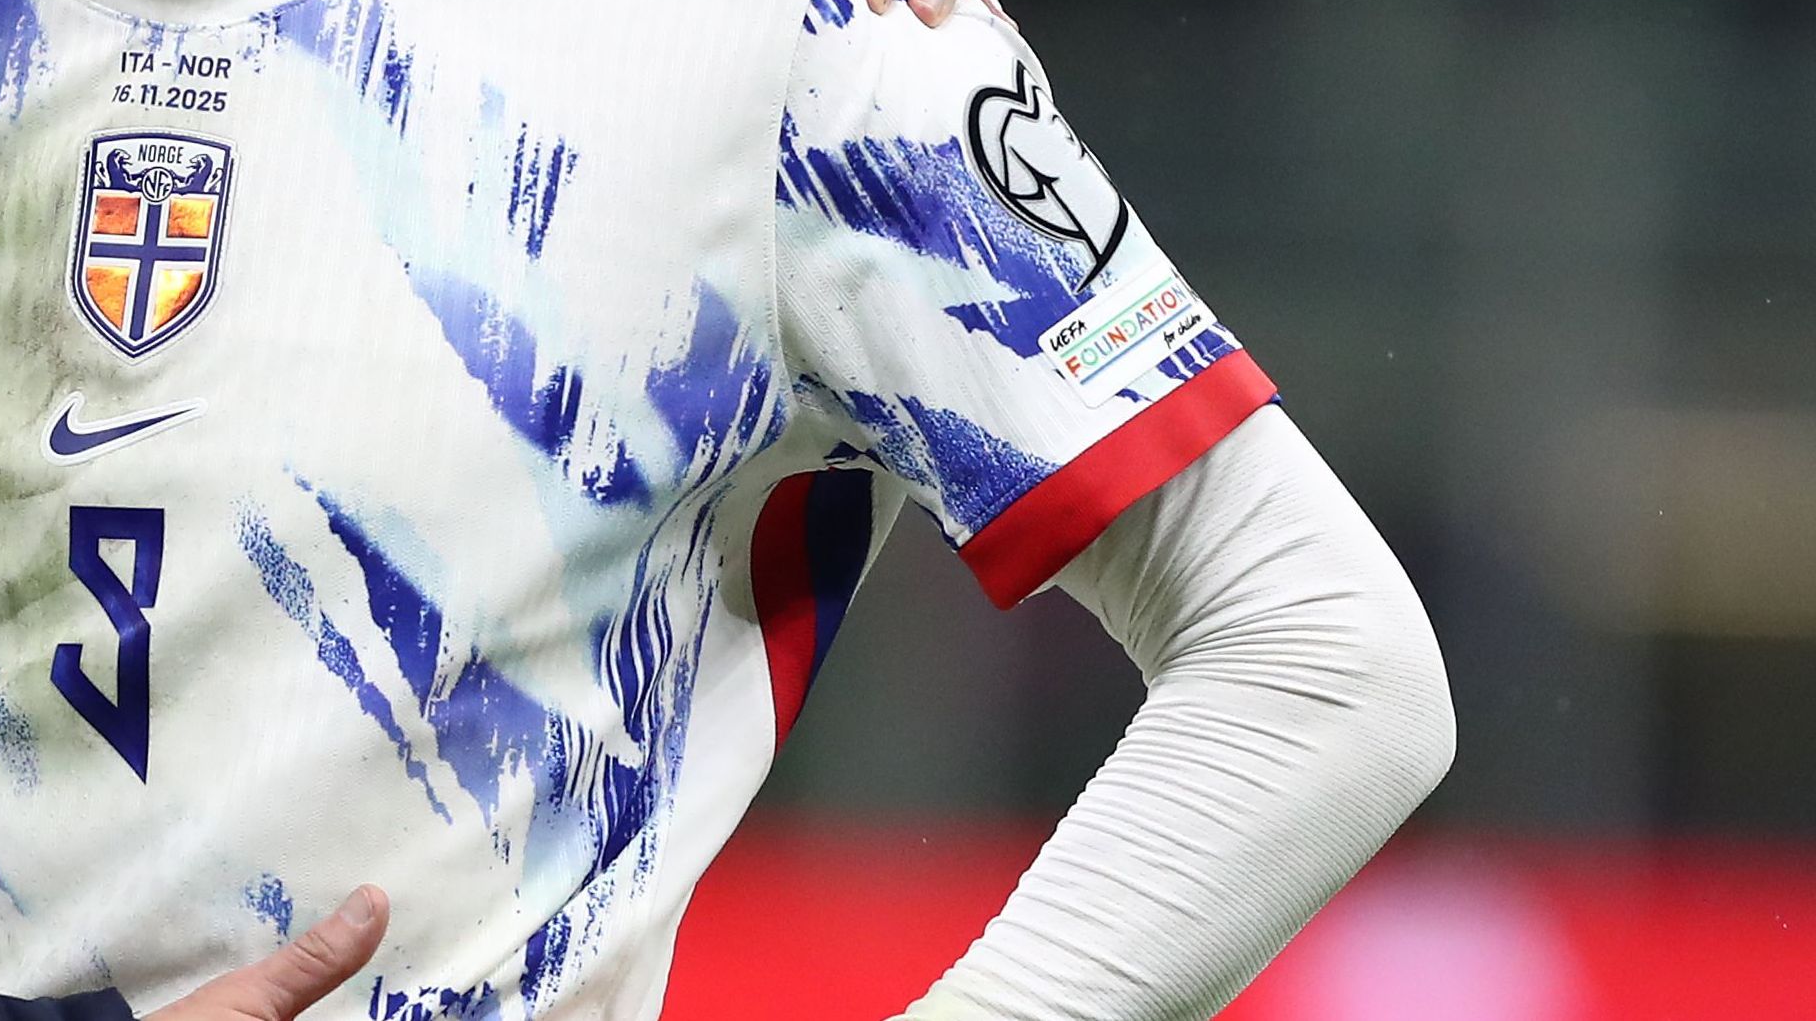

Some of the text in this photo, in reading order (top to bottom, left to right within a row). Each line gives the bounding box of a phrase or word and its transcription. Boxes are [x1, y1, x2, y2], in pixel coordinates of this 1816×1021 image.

[120, 51, 155, 74] ITA
[178, 54, 232, 79] NOR
[111, 83, 228, 112] 16.11.2025
[137, 143, 185, 164] NORGE
[1049, 319, 1088, 353] UEFA
[1065, 285, 1188, 378] FOUNDATION
